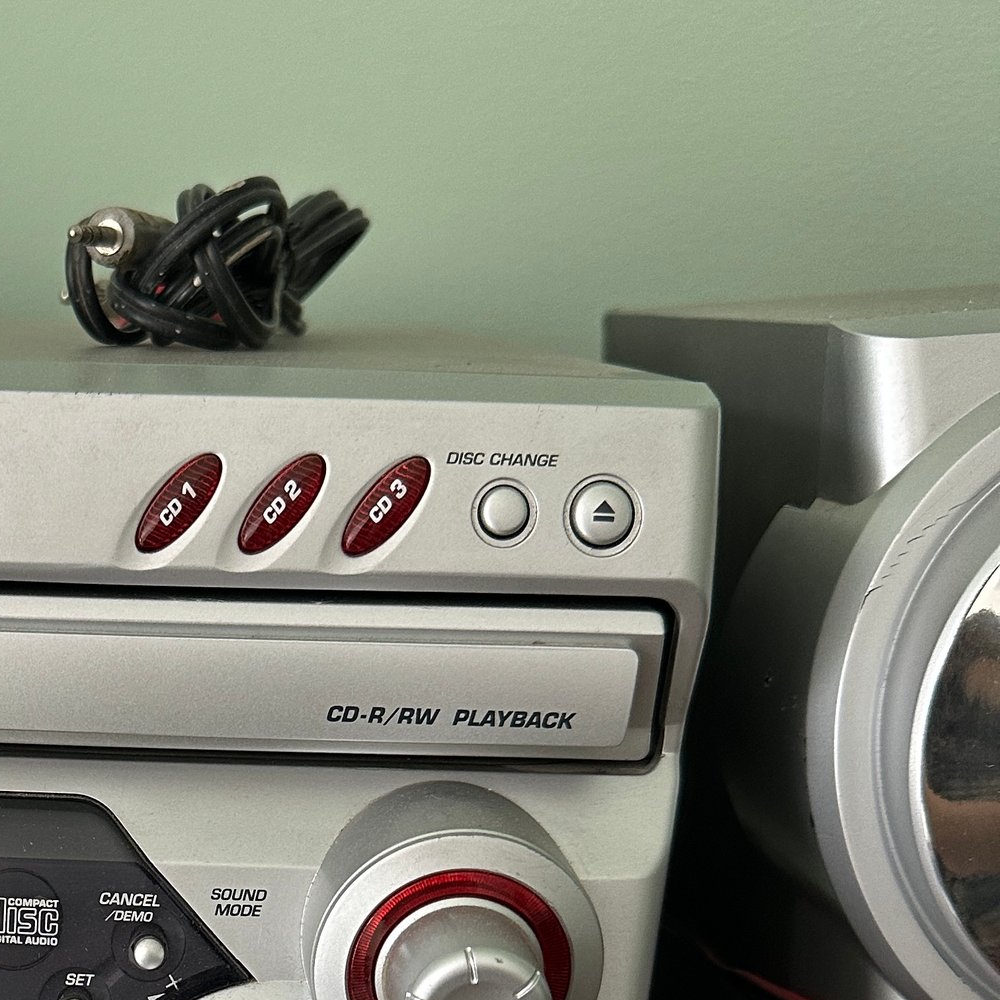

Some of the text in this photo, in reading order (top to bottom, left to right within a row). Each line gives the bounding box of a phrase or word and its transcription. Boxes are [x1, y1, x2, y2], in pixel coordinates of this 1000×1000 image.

[446, 452, 560, 467] DISC CHANGE
[159, 481, 197, 526] CD 1
[262, 479, 302, 524] CD 2
[368, 478, 407, 523] CD 3
[326, 705, 577, 729] CD-R/RW PLAYBACK
[99, 891, 161, 908] CANCEL
[210, 888, 268, 901] SOUND
[8, 898, 59, 908] COMPACT
[214, 904, 262, 917] MODE
[25, 936, 58, 946] AUDIO
[65, 973, 96, 987] SET
